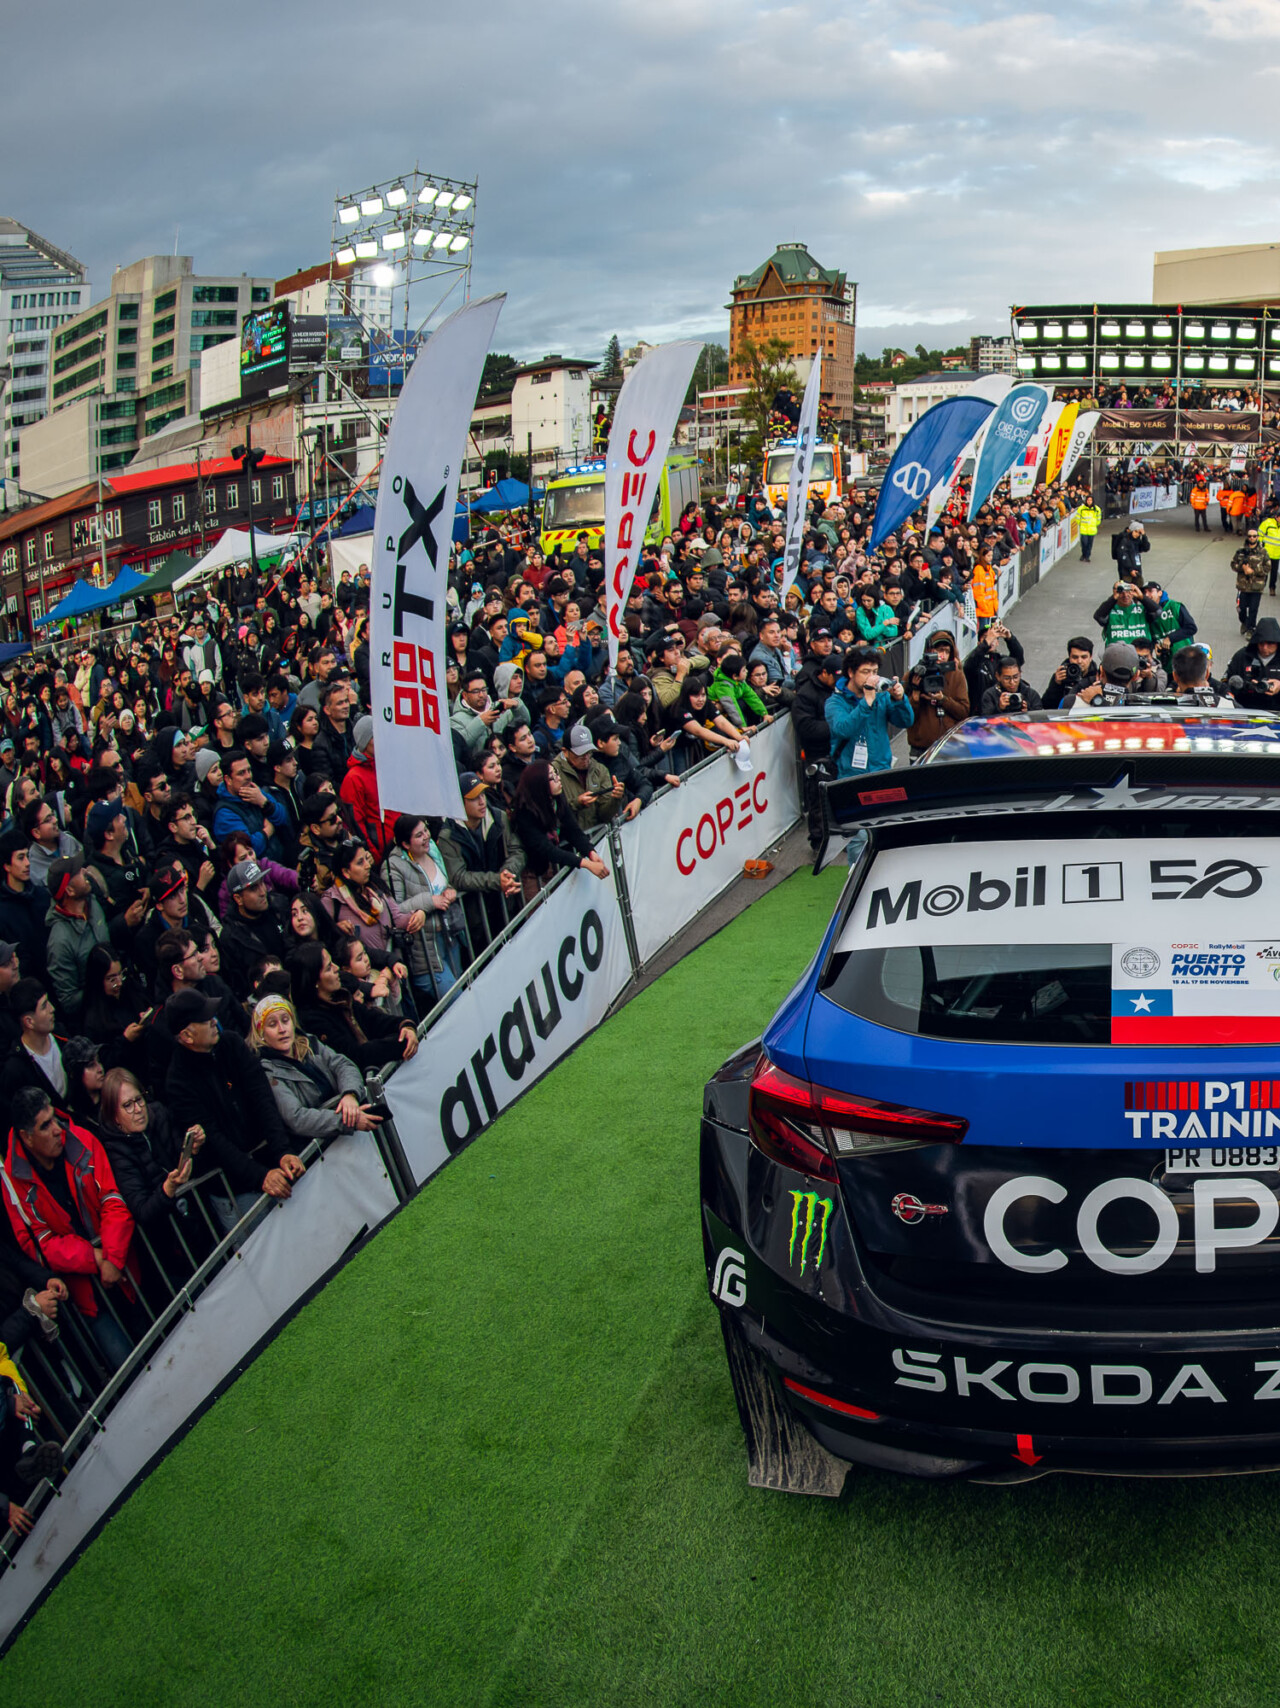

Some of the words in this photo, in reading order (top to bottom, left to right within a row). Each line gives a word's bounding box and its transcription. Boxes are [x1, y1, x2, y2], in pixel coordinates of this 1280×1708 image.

[1102, 421, 1121, 429] Mobil
[1129, 421, 1141, 429] 50
[1142, 421, 1167, 429] YEARS
[1186, 422, 1206, 430] Mobil
[1227, 423, 1251, 431] YEARS
[178, 524, 191, 535] del
[193, 519, 219, 532] Acla
[1111, 629, 1147, 639] PRENSA
[675, 771, 768, 876] COPEC
[864, 864, 1046, 931] Mobil
[1150, 858, 1268, 901] 50
[1171, 953, 1246, 965] PUERTO
[1171, 964, 1245, 976] MONTT
[440, 909, 604, 1155] arauco
[1204, 1081, 1245, 1110] P1
[1168, 1148, 1200, 1168] PR
[1211, 1146, 1278, 1167] 0883
